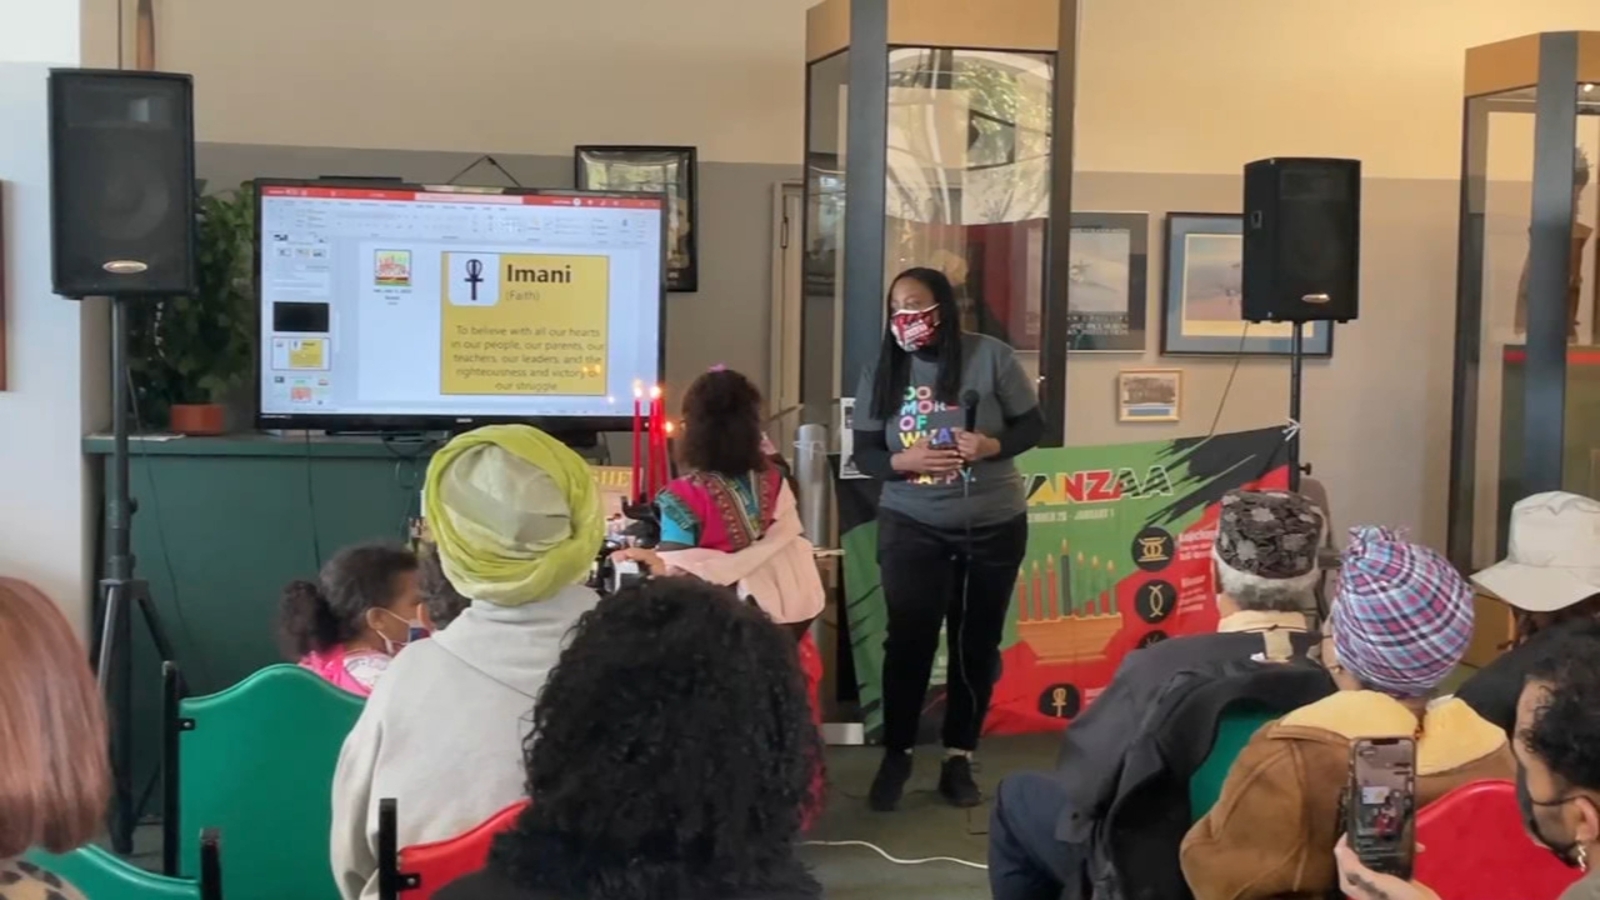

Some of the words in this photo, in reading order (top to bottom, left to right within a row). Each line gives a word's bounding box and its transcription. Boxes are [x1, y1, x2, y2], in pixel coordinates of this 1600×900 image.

[506, 264, 571, 283] Imani
[505, 290, 541, 301] (Faith)
[456, 325, 468, 335] To
[471, 326, 507, 336] believe
[510, 326, 532, 336] with
[535, 327, 546, 336] all
[548, 328, 567, 337] our
[569, 328, 600, 337] hearts
[451, 340, 461, 348] in
[463, 341, 481, 349] our
[586, 343, 604, 351] our
[501, 355, 519, 363] our
[563, 355, 583, 364] and
[585, 355, 602, 364] the
[456, 367, 527, 379] righteousness
[529, 367, 549, 377] and
[552, 369, 585, 380] victory
[495, 383, 513, 391] our
[899, 415, 928, 431] OF
[1022, 465, 1174, 506] ANZAA
[1027, 511, 1056, 523] EMBER
